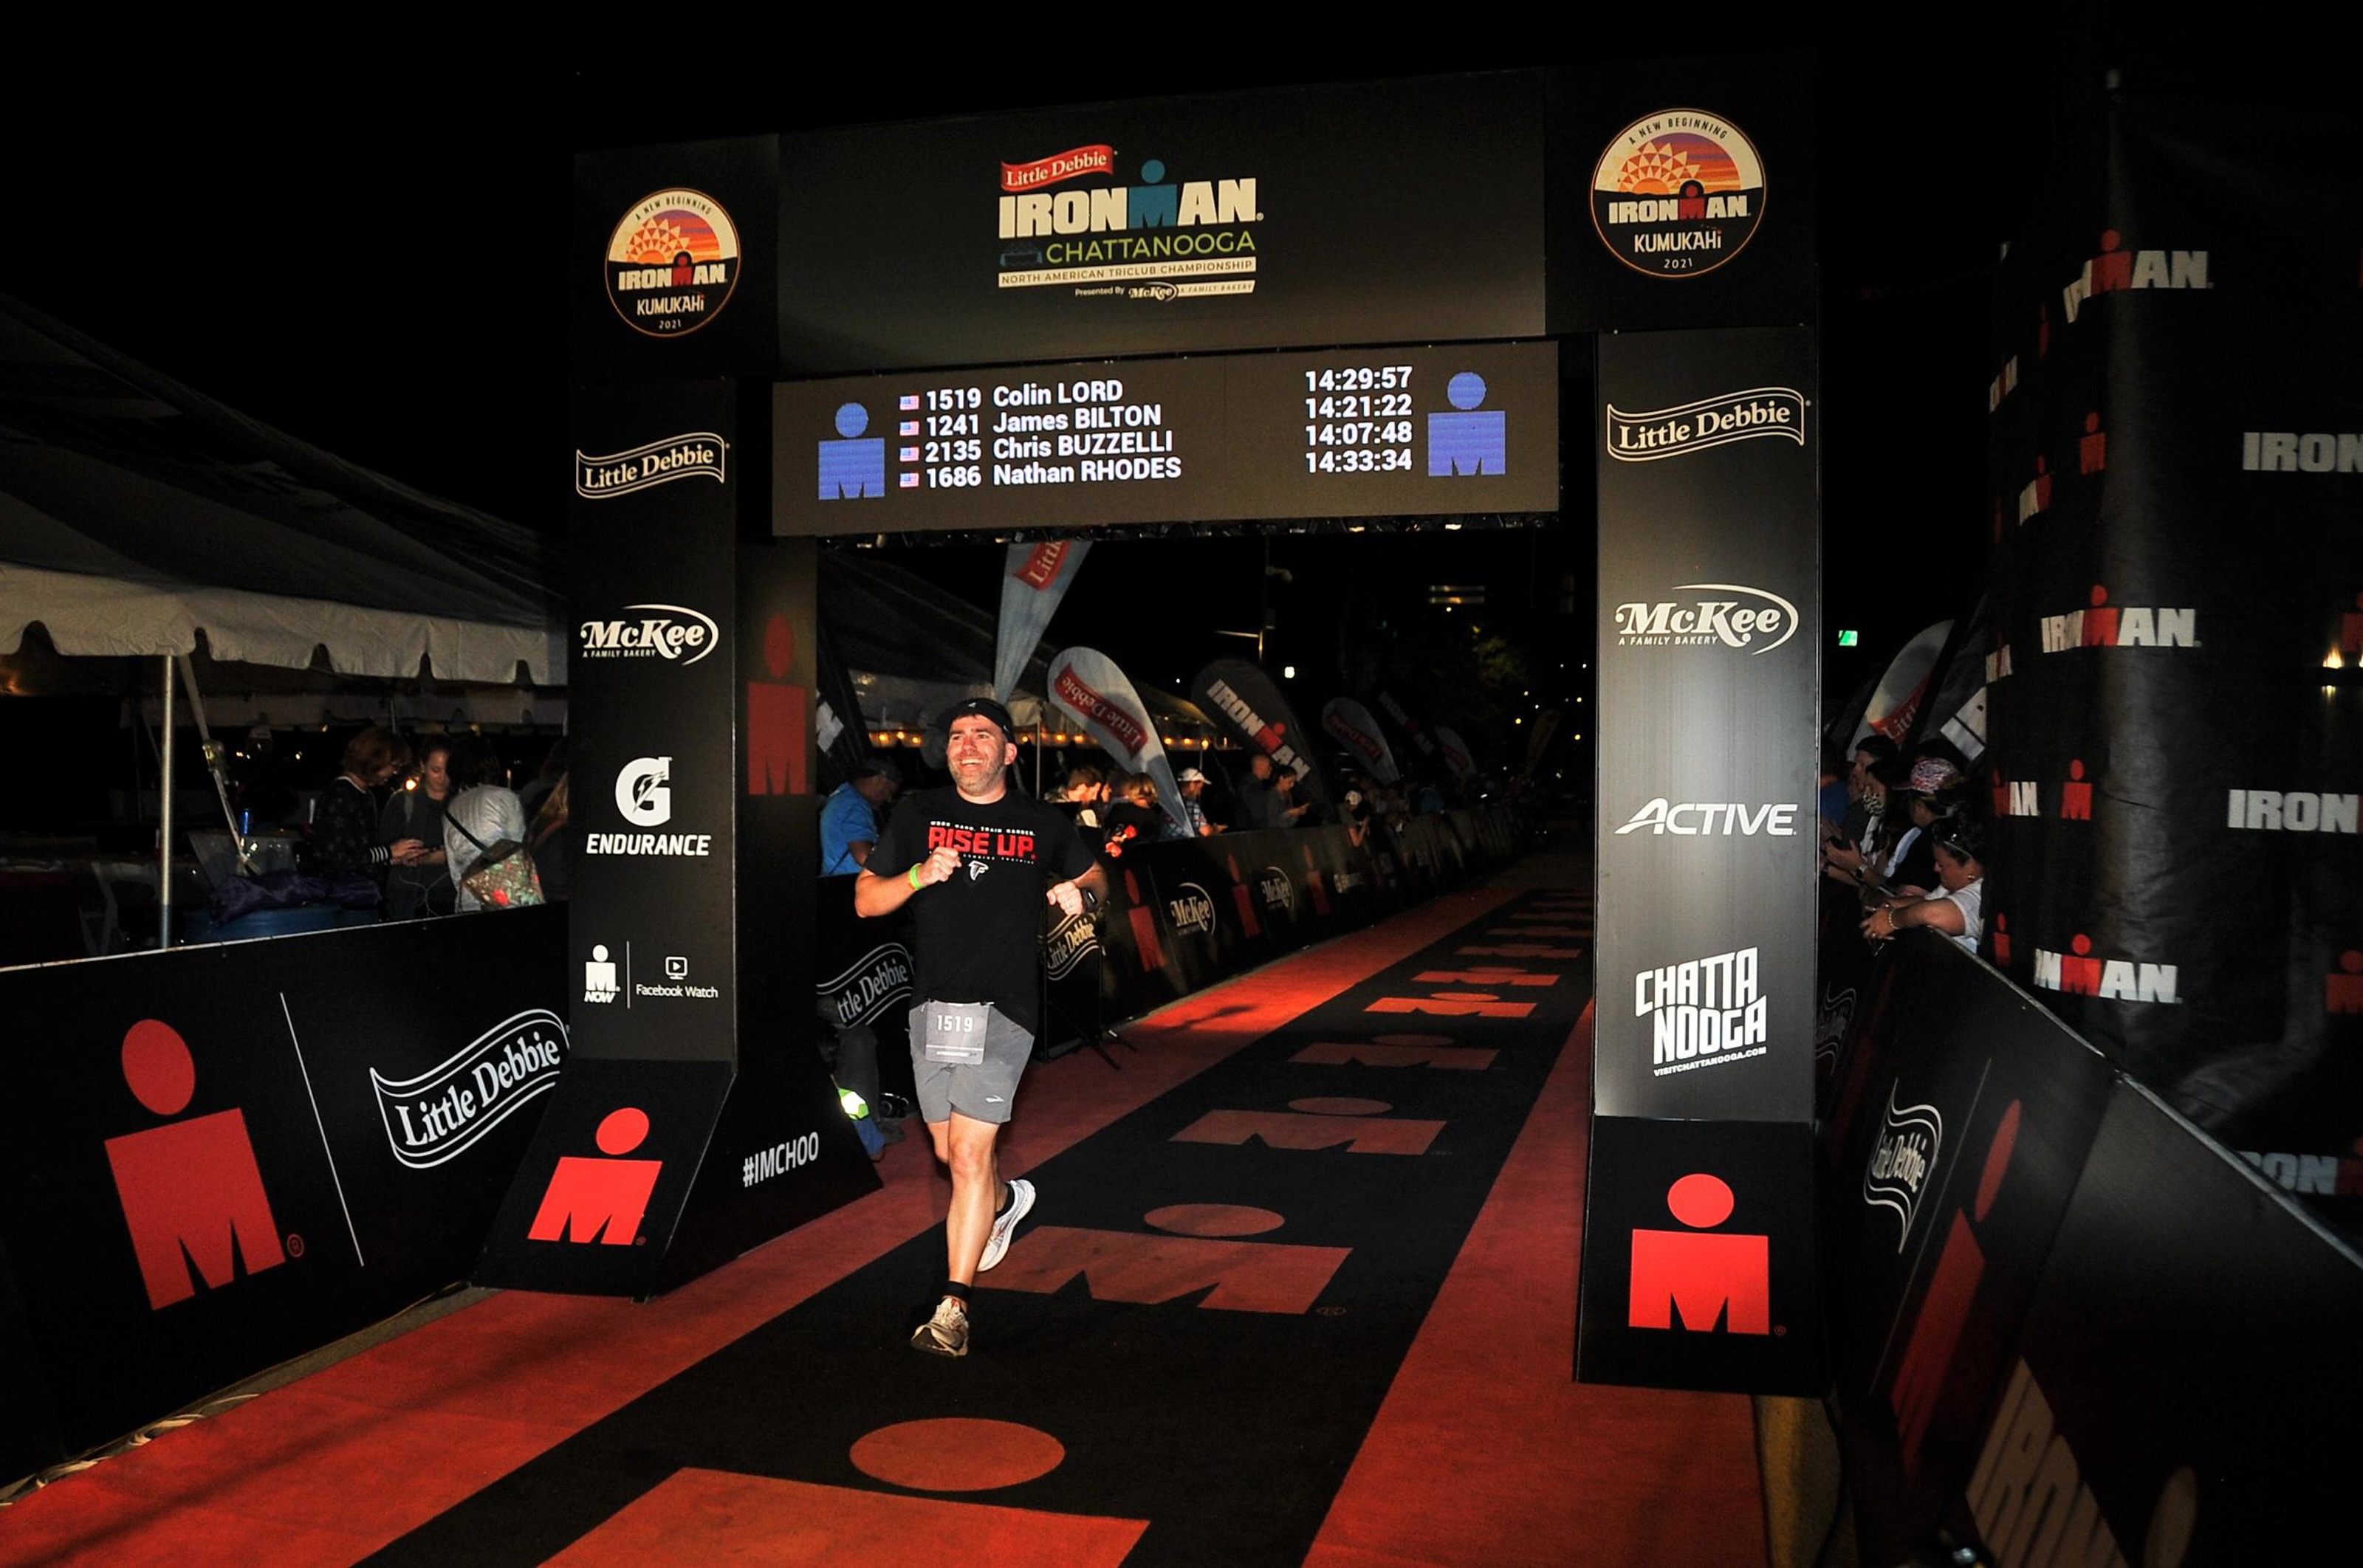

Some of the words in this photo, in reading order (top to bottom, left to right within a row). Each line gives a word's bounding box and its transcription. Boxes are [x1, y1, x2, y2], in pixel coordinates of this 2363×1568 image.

[1628, 136, 1636, 145] A
[1639, 120, 1661, 138] NEW
[1667, 117, 1729, 140] BEGINNING
[1006, 166, 1048, 188] Little
[1052, 150, 1108, 178] Debbie
[643, 200, 661, 213] NEW
[665, 196, 712, 216] BEGINNING
[999, 159, 1256, 239] IRONMAN
[1608, 185, 1748, 224] IRONMAN
[1046, 230, 1256, 265] CHATTANOOGA
[1663, 258, 1693, 269] 2021
[618, 252, 726, 292] IRONMAN
[1001, 274, 1041, 286] NORTH
[1044, 269, 1105, 283] AMERICAN
[1108, 264, 1157, 278] TRICLUB
[1160, 259, 1252, 275] CHAMPIONSHIP
[1074, 286, 1114, 297] Presented
[1116, 286, 1125, 296] By
[1128, 281, 1174, 301] McKee
[658, 319, 682, 330] 2021
[925, 388, 981, 411] 1519
[992, 382, 1052, 408] Colin
[1057, 379, 1123, 404] LORD
[1305, 366, 1413, 392] 14:29:57
[925, 414, 979, 437] 1241
[992, 410, 1069, 434] James
[1074, 405, 1162, 430] BILTON
[1305, 394, 1413, 419] 14:21:22
[1305, 422, 1413, 446] 14:07:48
[1619, 420, 1690, 450] Little
[1695, 400, 1791, 437] Debbie
[925, 439, 981, 463] 2135
[992, 434, 1052, 460] Chris
[1058, 430, 1173, 456] BUZZELLI
[1305, 448, 1413, 473] 14:33:34
[584, 464, 638, 489] Little
[641, 444, 714, 478] Debbie
[925, 466, 981, 488] 1686
[993, 461, 1074, 486] Nathan
[1080, 457, 1182, 482] RHODES
[580, 619, 704, 659] McKee
[1615, 602, 1781, 648] McKee
[1618, 636, 1625, 646] A
[1630, 636, 1670, 645] FAMILY
[1674, 636, 1718, 645] BAKERY
[582, 650, 588, 659] A
[591, 650, 620, 659] FAMILY
[623, 650, 656, 658] BAKERY
[1614, 797, 1798, 836] ACTIVE
[2227, 788, 2363, 833] IRON
[586, 833, 711, 856] ENDURANCE
[929, 826, 990, 855] RISE
[584, 991, 616, 1003] NOW
[636, 983, 683, 997] Facebook
[685, 985, 718, 999] Watch
[859, 957, 909, 1007] Debbie
[1636, 946, 1757, 1017] CHATTA
[937, 1014, 973, 1032] 1519
[1653, 994, 1766, 1065] NOOGA
[1653, 1045, 1767, 1077] VISITCHATTANOOGA.COM
[395, 1084, 476, 1146] Little
[470, 1031, 560, 1108] Debbie
[743, 1131, 819, 1188] #IMCHOO
